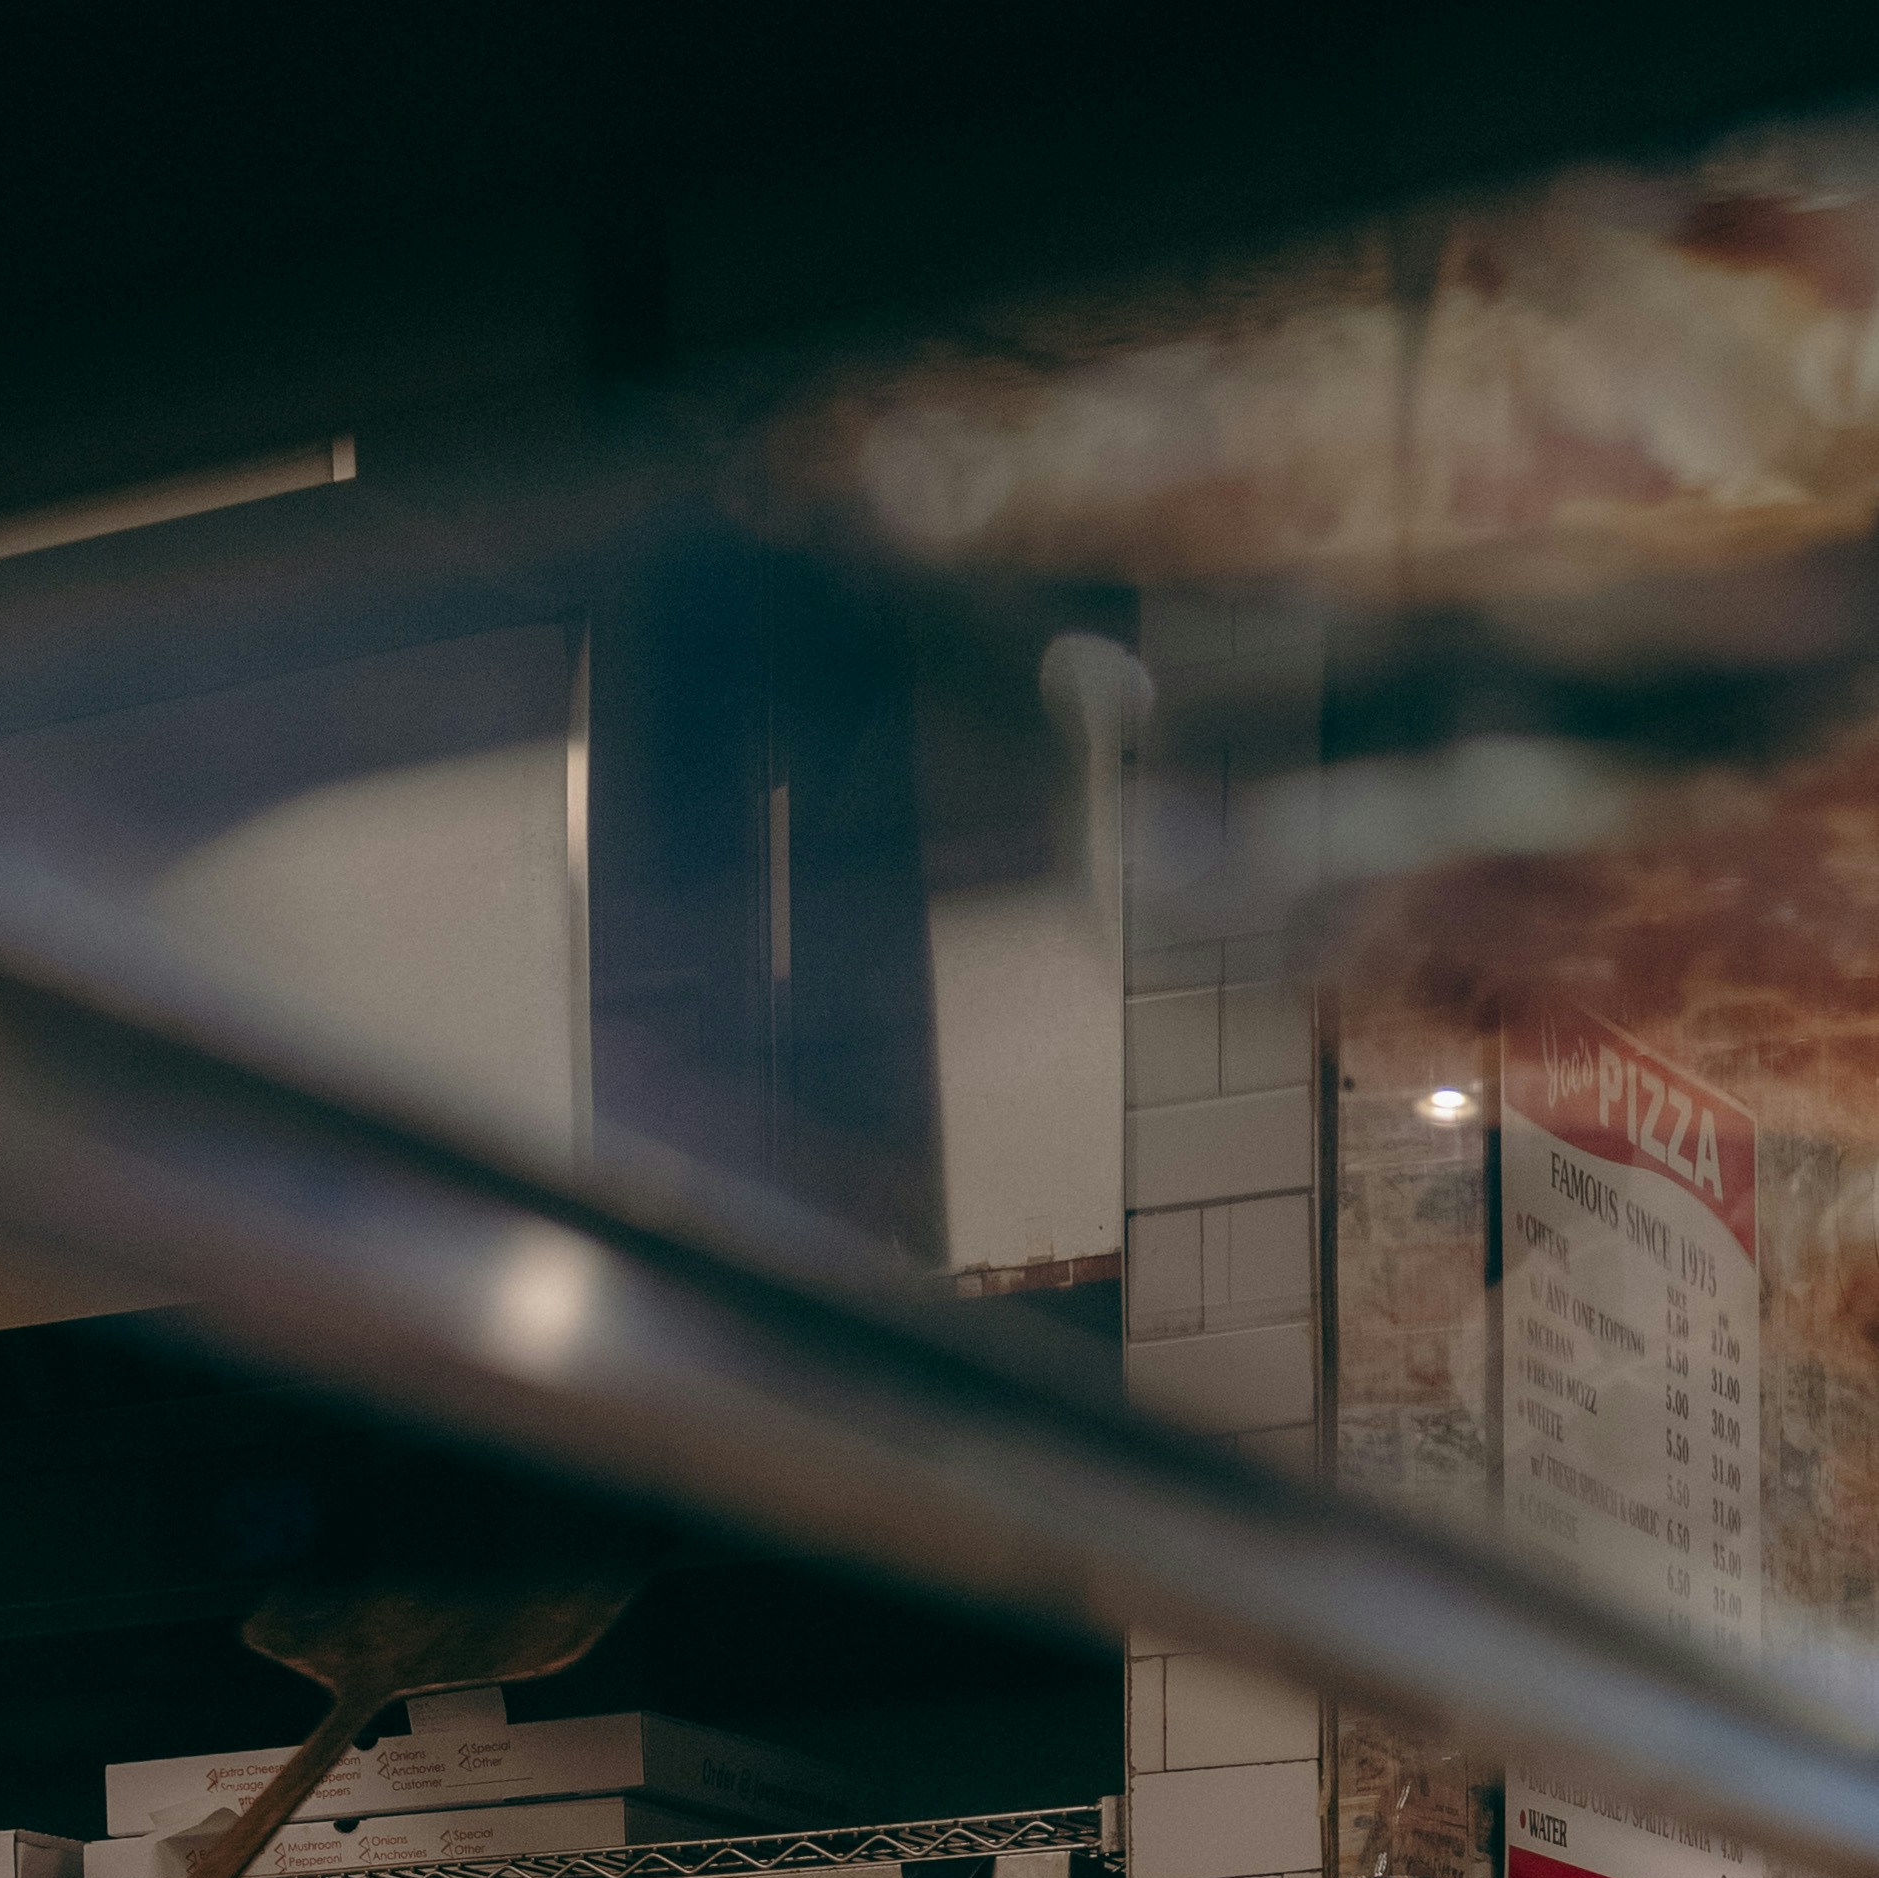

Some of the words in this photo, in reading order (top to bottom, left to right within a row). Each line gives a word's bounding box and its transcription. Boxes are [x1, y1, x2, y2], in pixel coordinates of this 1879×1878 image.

[1598, 1043, 1724, 1203] PIZZA
[1551, 1150, 1620, 1230] FAMOUS
[1625, 1199, 1673, 1271] SINCE
[1680, 1236, 1718, 1299] 1975
[1526, 1214, 1571, 1274] CHEESE
[1546, 1279, 1570, 1321] ANY
[1572, 1298, 1596, 1337] ONE
[1598, 1313, 1646, 1357] TOPPING
[1711, 1368, 1741, 1406] 31.00
[1527, 1317, 1575, 1364] SICILIAN
[1665, 1385, 1689, 1421] 5.00
[1711, 1407, 1741, 1449] 30.00
[1527, 1358, 1564, 1398] FRESH
[1566, 1375, 1599, 1417] MOZZ
[1665, 1427, 1690, 1466] 5.50
[1711, 1454, 1741, 1494] 31.00
[1527, 1397, 1565, 1443] WHITE
[1666, 1473, 1691, 1511] 5.50
[1712, 1497, 1741, 1537] 31.00
[1666, 1518, 1691, 1555] 6.50
[1712, 1541, 1741, 1581] 35.00
[1667, 1563, 1692, 1601] 6.50
[471, 1740, 511, 1755] Special
[389, 1750, 426, 1762] Onions
[472, 1757, 503, 1768] Other
[218, 1766, 244, 1778] Extra
[391, 1762, 446, 1776] Anchovies
[702, 1757, 737, 1791] Order
[392, 1777, 443, 1792] Customer
[453, 1827, 494, 1841] Special
[1528, 1808, 1568, 1849] WATER
[287, 1840, 342, 1852] Mushroom
[371, 1835, 408, 1846] Onions
[373, 1847, 427, 1860] Anchovies
[455, 1843, 486, 1856] Other
[288, 1854, 342, 1868] Pepperoni
